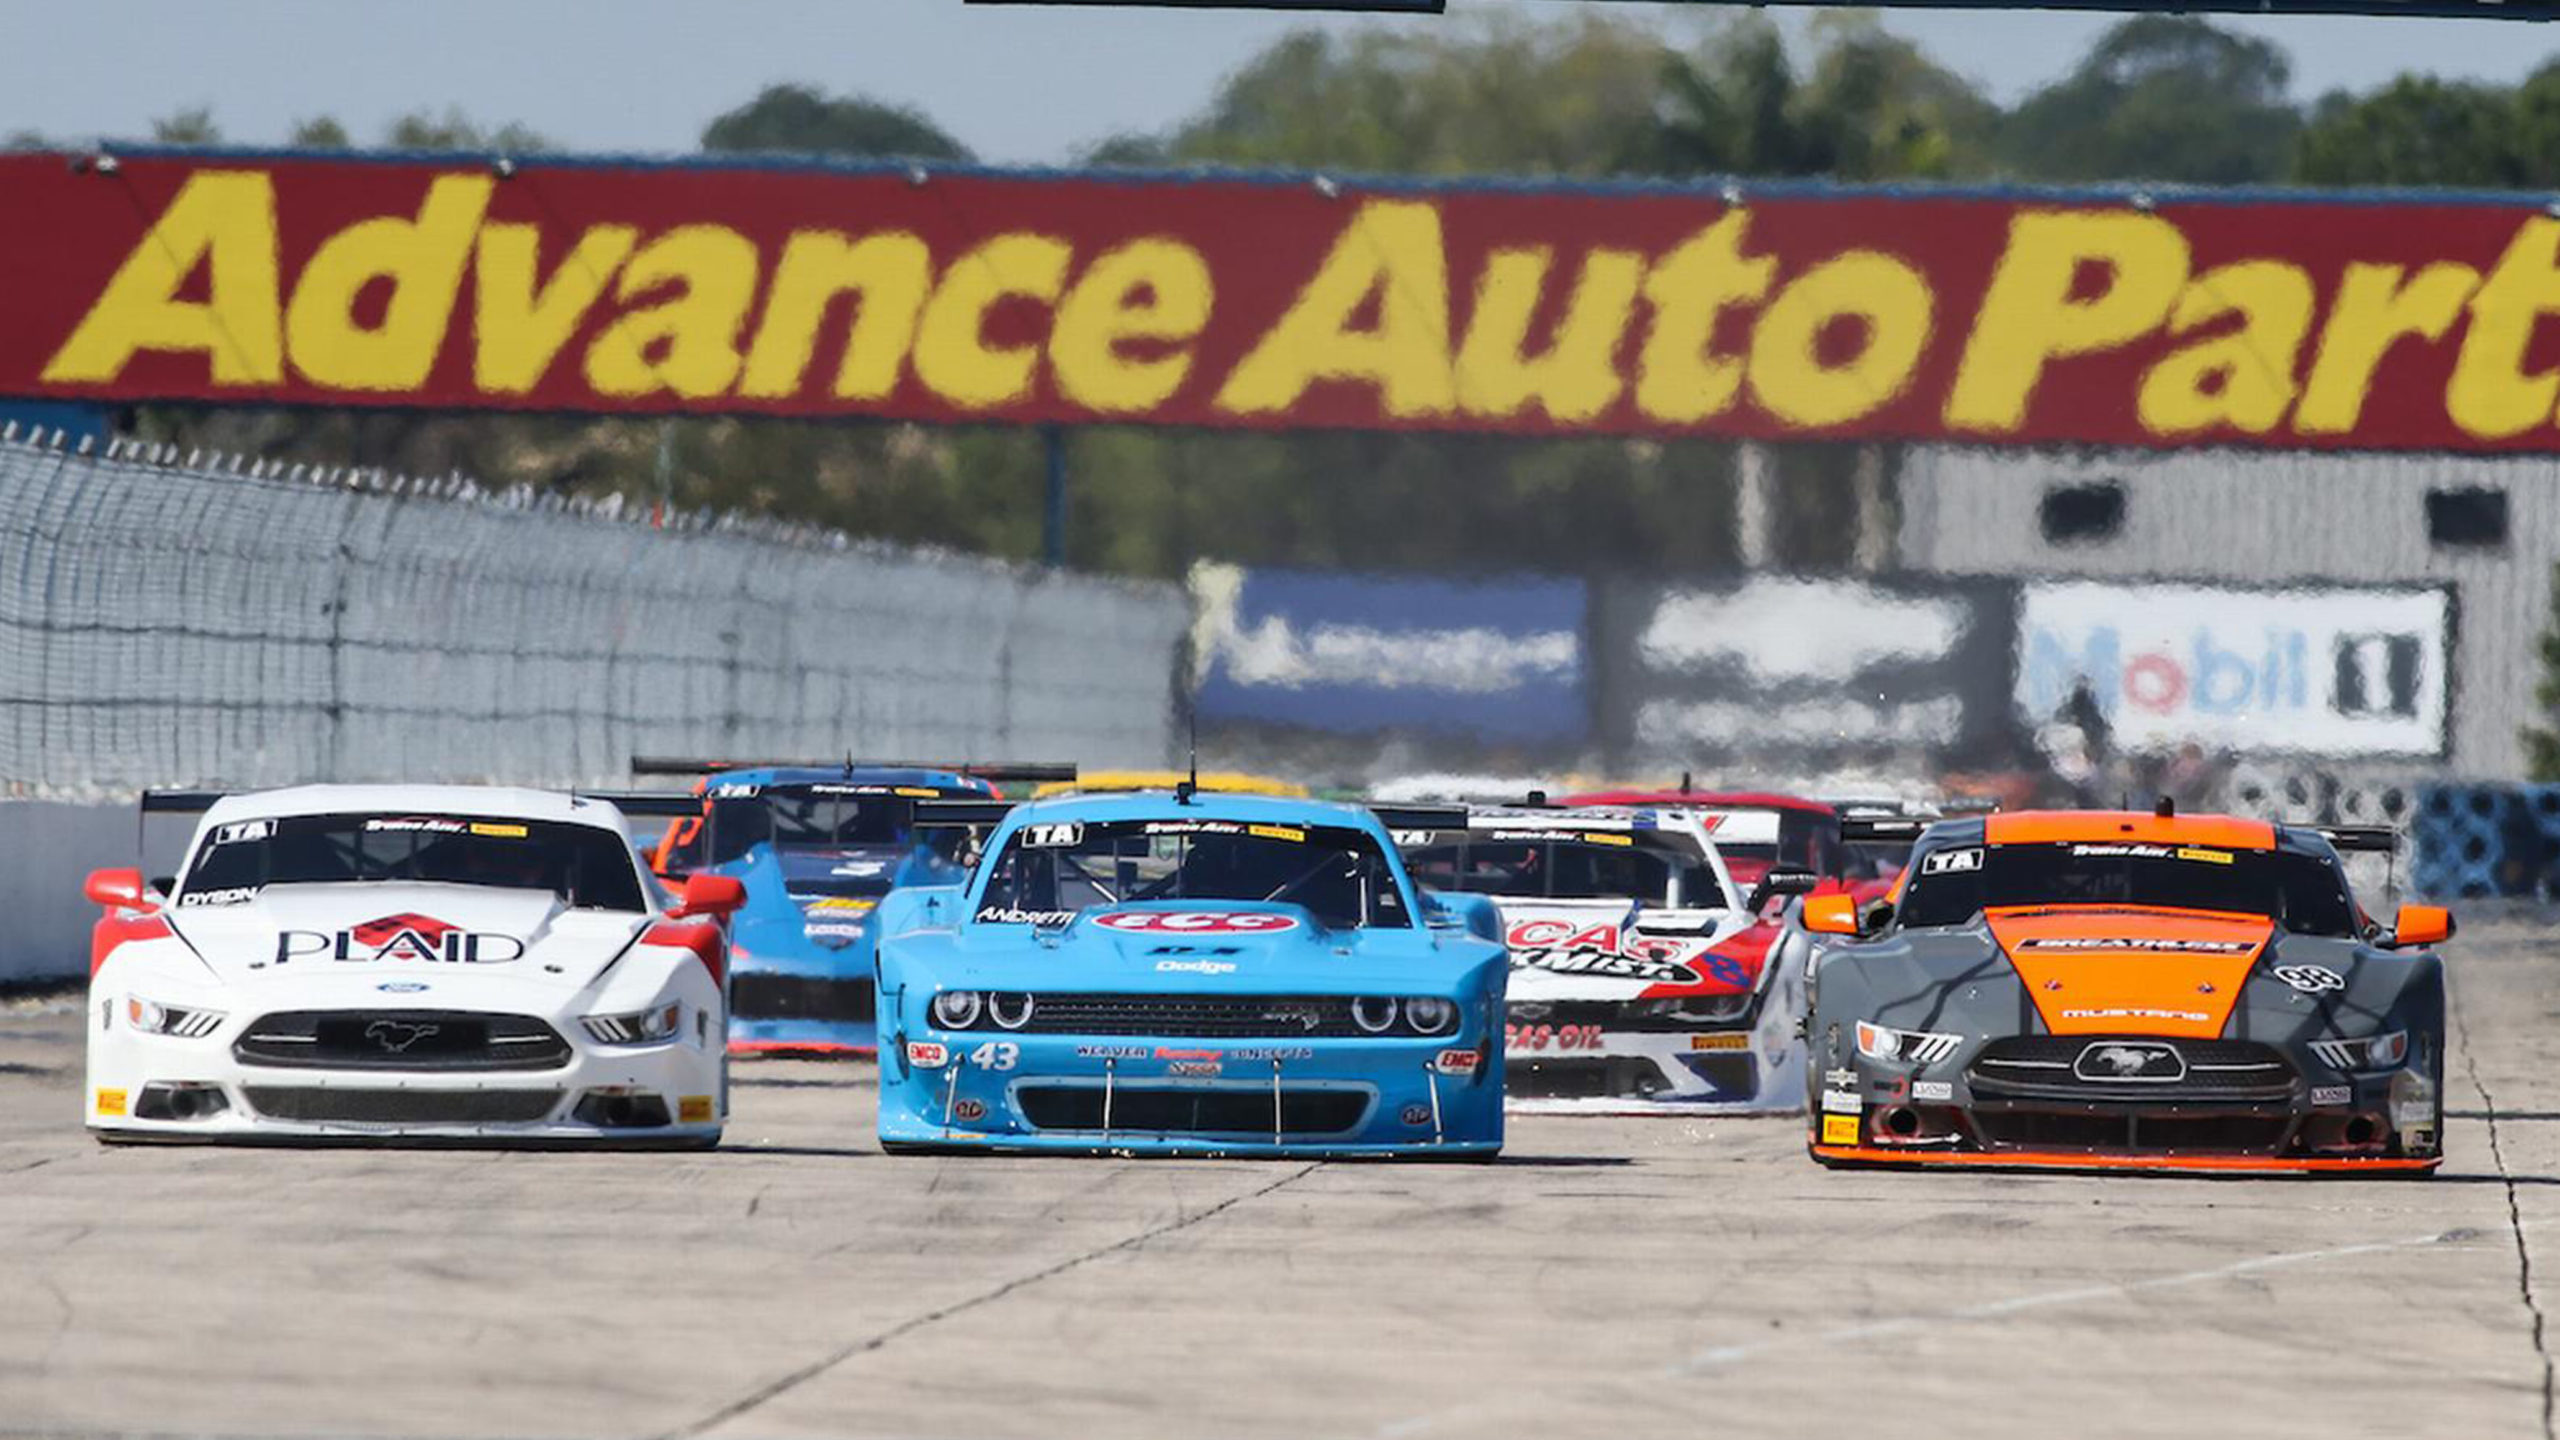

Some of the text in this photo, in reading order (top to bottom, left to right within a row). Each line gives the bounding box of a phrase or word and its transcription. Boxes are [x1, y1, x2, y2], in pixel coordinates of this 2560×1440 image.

[38, 169, 2560, 439] Advance Auto Part
[2028, 625, 2308, 713] Mobil
[223, 823, 268, 841] TA
[1033, 824, 1074, 844] TA
[1932, 852, 1974, 870] TA
[182, 887, 258, 907] DYSON
[976, 905, 1076, 925] ANDRETTI
[1113, 913, 1276, 928] ECC
[275, 930, 525, 965] PLAID
[2037, 938, 2240, 950] BREATHLESS
[1155, 959, 1237, 974] Dodge
[1702, 952, 1750, 987] 8
[2277, 966, 2343, 990] 98
[2062, 1009, 2209, 1021] MUSTANG
[1557, 1023, 1604, 1050] OIL
[971, 1043, 1019, 1070] 43
